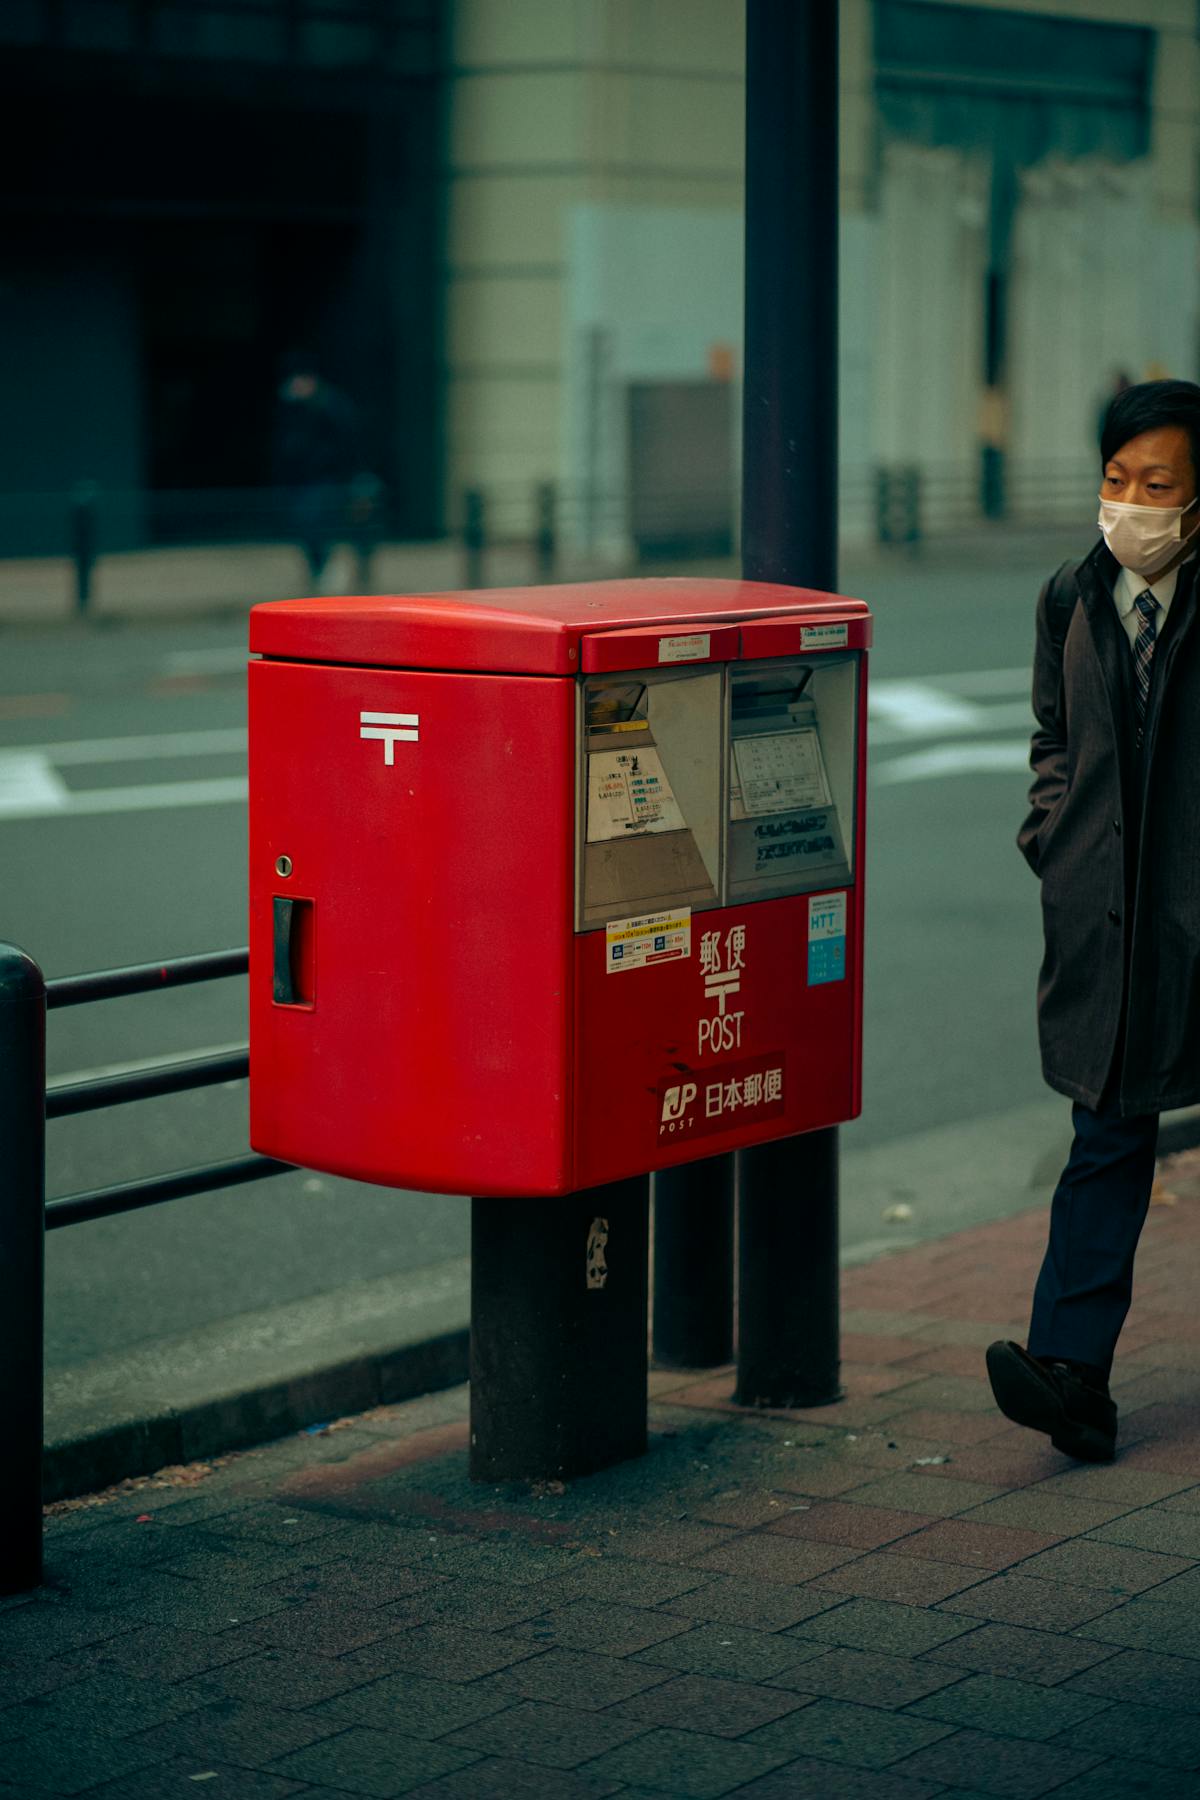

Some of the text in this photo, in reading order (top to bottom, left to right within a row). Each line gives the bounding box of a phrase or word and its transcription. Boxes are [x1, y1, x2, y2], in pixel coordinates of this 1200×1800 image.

[811, 912, 835, 930] HTT
[700, 925, 746, 975] 郵便
[698, 1011, 745, 1056] POST
[705, 1068, 783, 1118] 日本郵便
[659, 1117, 695, 1135] POST
